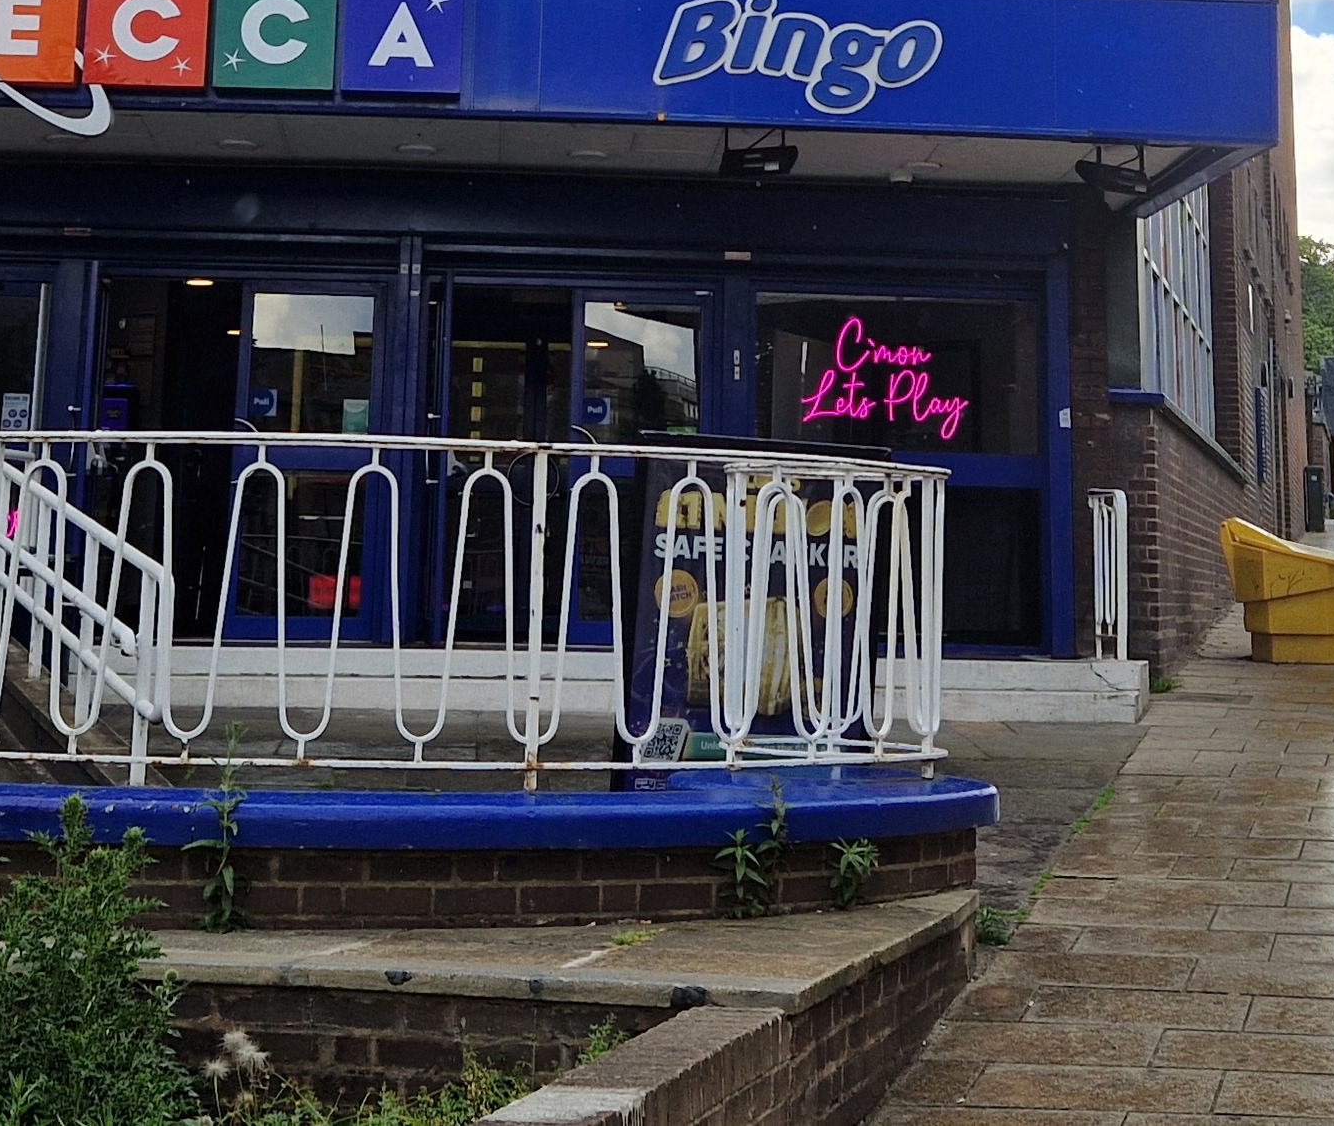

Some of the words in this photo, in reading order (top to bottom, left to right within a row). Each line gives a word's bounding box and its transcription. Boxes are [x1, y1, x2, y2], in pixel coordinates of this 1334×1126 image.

[252, 396, 270, 407] Pull
[800, 368, 877, 424] Lets
[883, 368, 970, 441] Play
[586, 404, 603, 415] Pull
[654, 533, 723, 562] SAFE
[671, 584, 687, 593] ASH
[670, 591, 693, 602] ATCH
